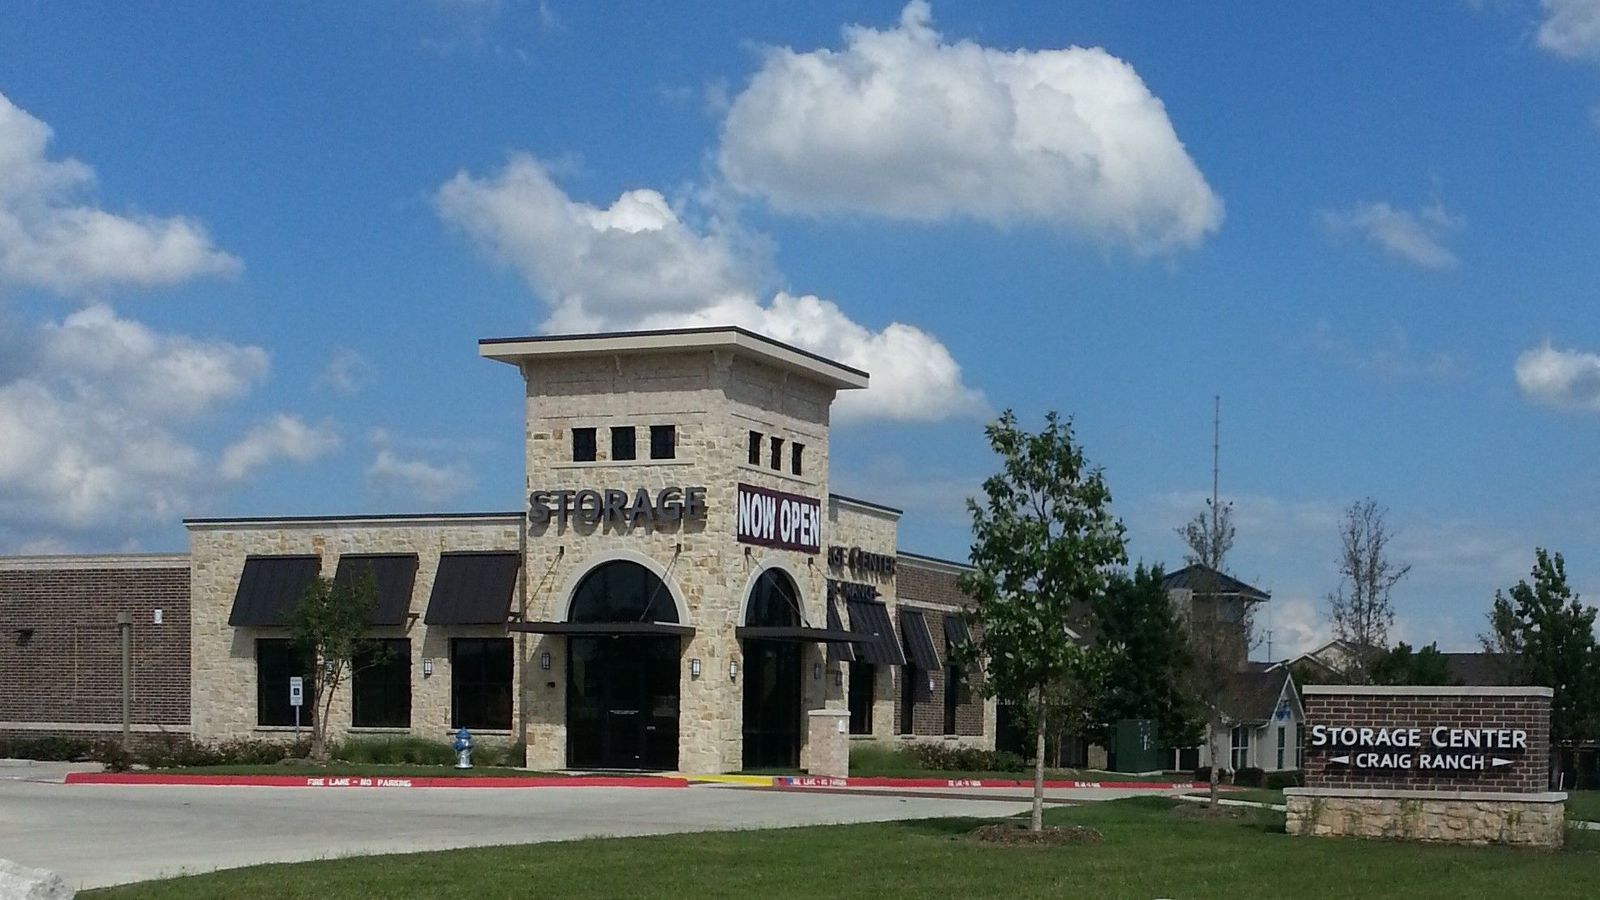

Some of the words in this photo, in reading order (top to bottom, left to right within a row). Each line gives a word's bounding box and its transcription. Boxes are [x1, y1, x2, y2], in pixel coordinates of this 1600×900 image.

[529, 487, 707, 523] STORAGE
[739, 490, 776, 539] NOW
[780, 499, 820, 547] OPEN
[849, 547, 897, 575] CENTER
[1312, 725, 1421, 747] STORAGE
[1431, 726, 1527, 749] CENTER
[1356, 753, 1411, 769] CRAIG
[1419, 754, 1484, 770] RANCH
[307, 778, 324, 786] FIRE
[329, 778, 350, 786] LANE
[360, 778, 372, 786] NO
[377, 779, 412, 787] PARKING
